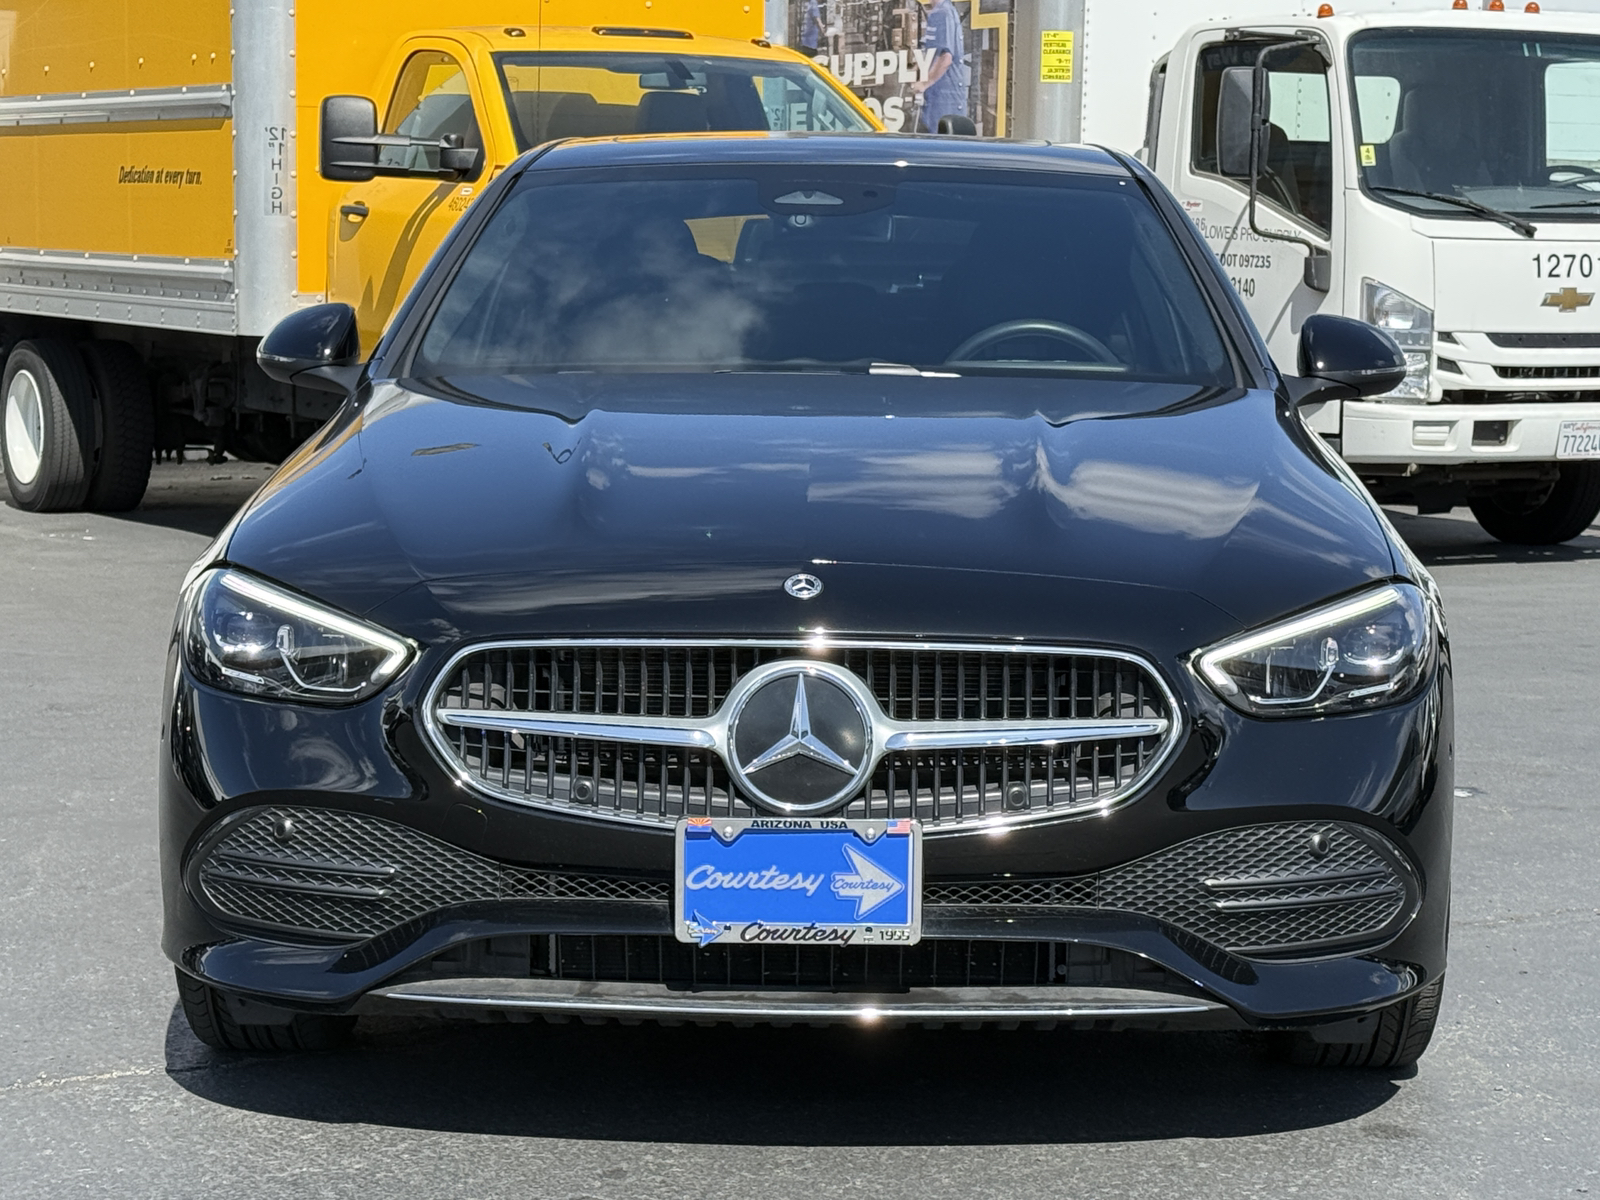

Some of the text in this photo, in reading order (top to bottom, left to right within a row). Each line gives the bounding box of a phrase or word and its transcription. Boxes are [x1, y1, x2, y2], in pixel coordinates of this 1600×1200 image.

[118, 166, 154, 184] Dedication
[156, 167, 163, 184] at
[164, 170, 183, 189] every
[1239, 254, 1271, 269] 097235
[1532, 254, 1600, 278] 1270
[1563, 434, 1600, 453] 77224
[750, 820, 848, 829] ARIZONA USA
[686, 864, 824, 896] Courtesy
[833, 879, 895, 892] Courtesy
[740, 921, 856, 946] Courtesy
